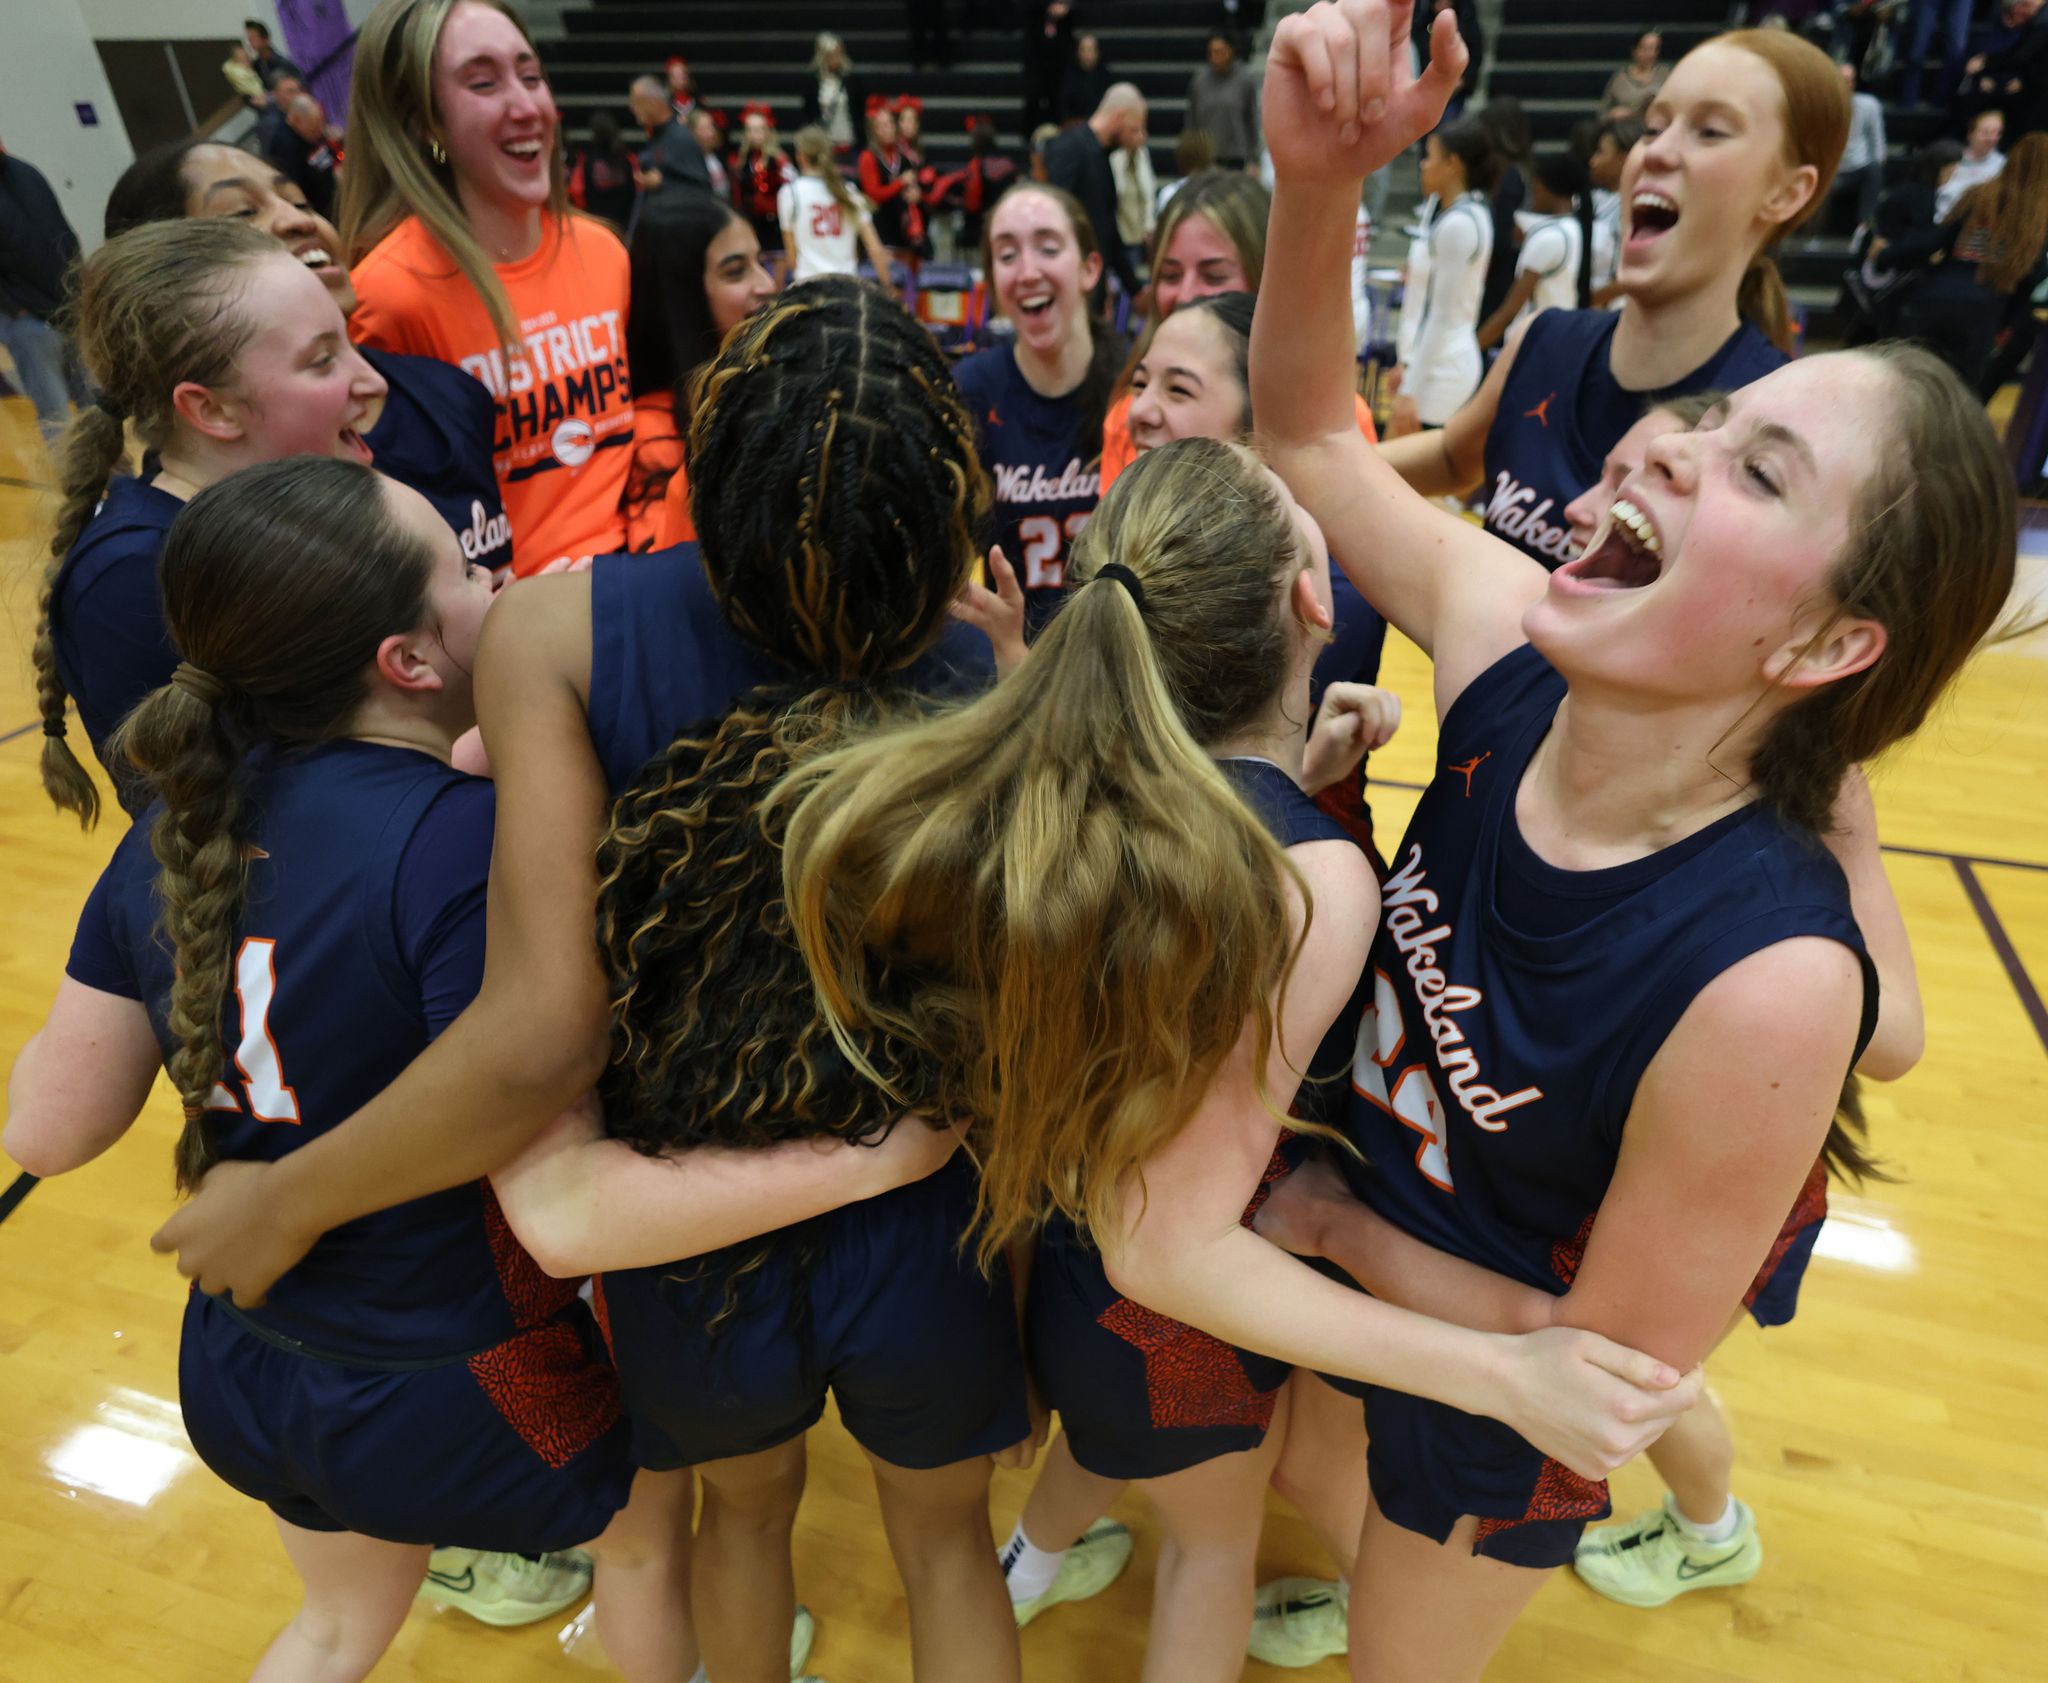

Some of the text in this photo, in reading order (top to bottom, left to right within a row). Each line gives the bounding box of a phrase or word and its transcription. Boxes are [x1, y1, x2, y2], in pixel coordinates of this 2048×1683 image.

[459, 309, 620, 401] DISTRICT
[993, 457, 1100, 503] Wakelan
[1018, 512, 1094, 590] 2
[202, 935, 301, 1125] 1
[1382, 842, 1545, 1133] Wakeland
